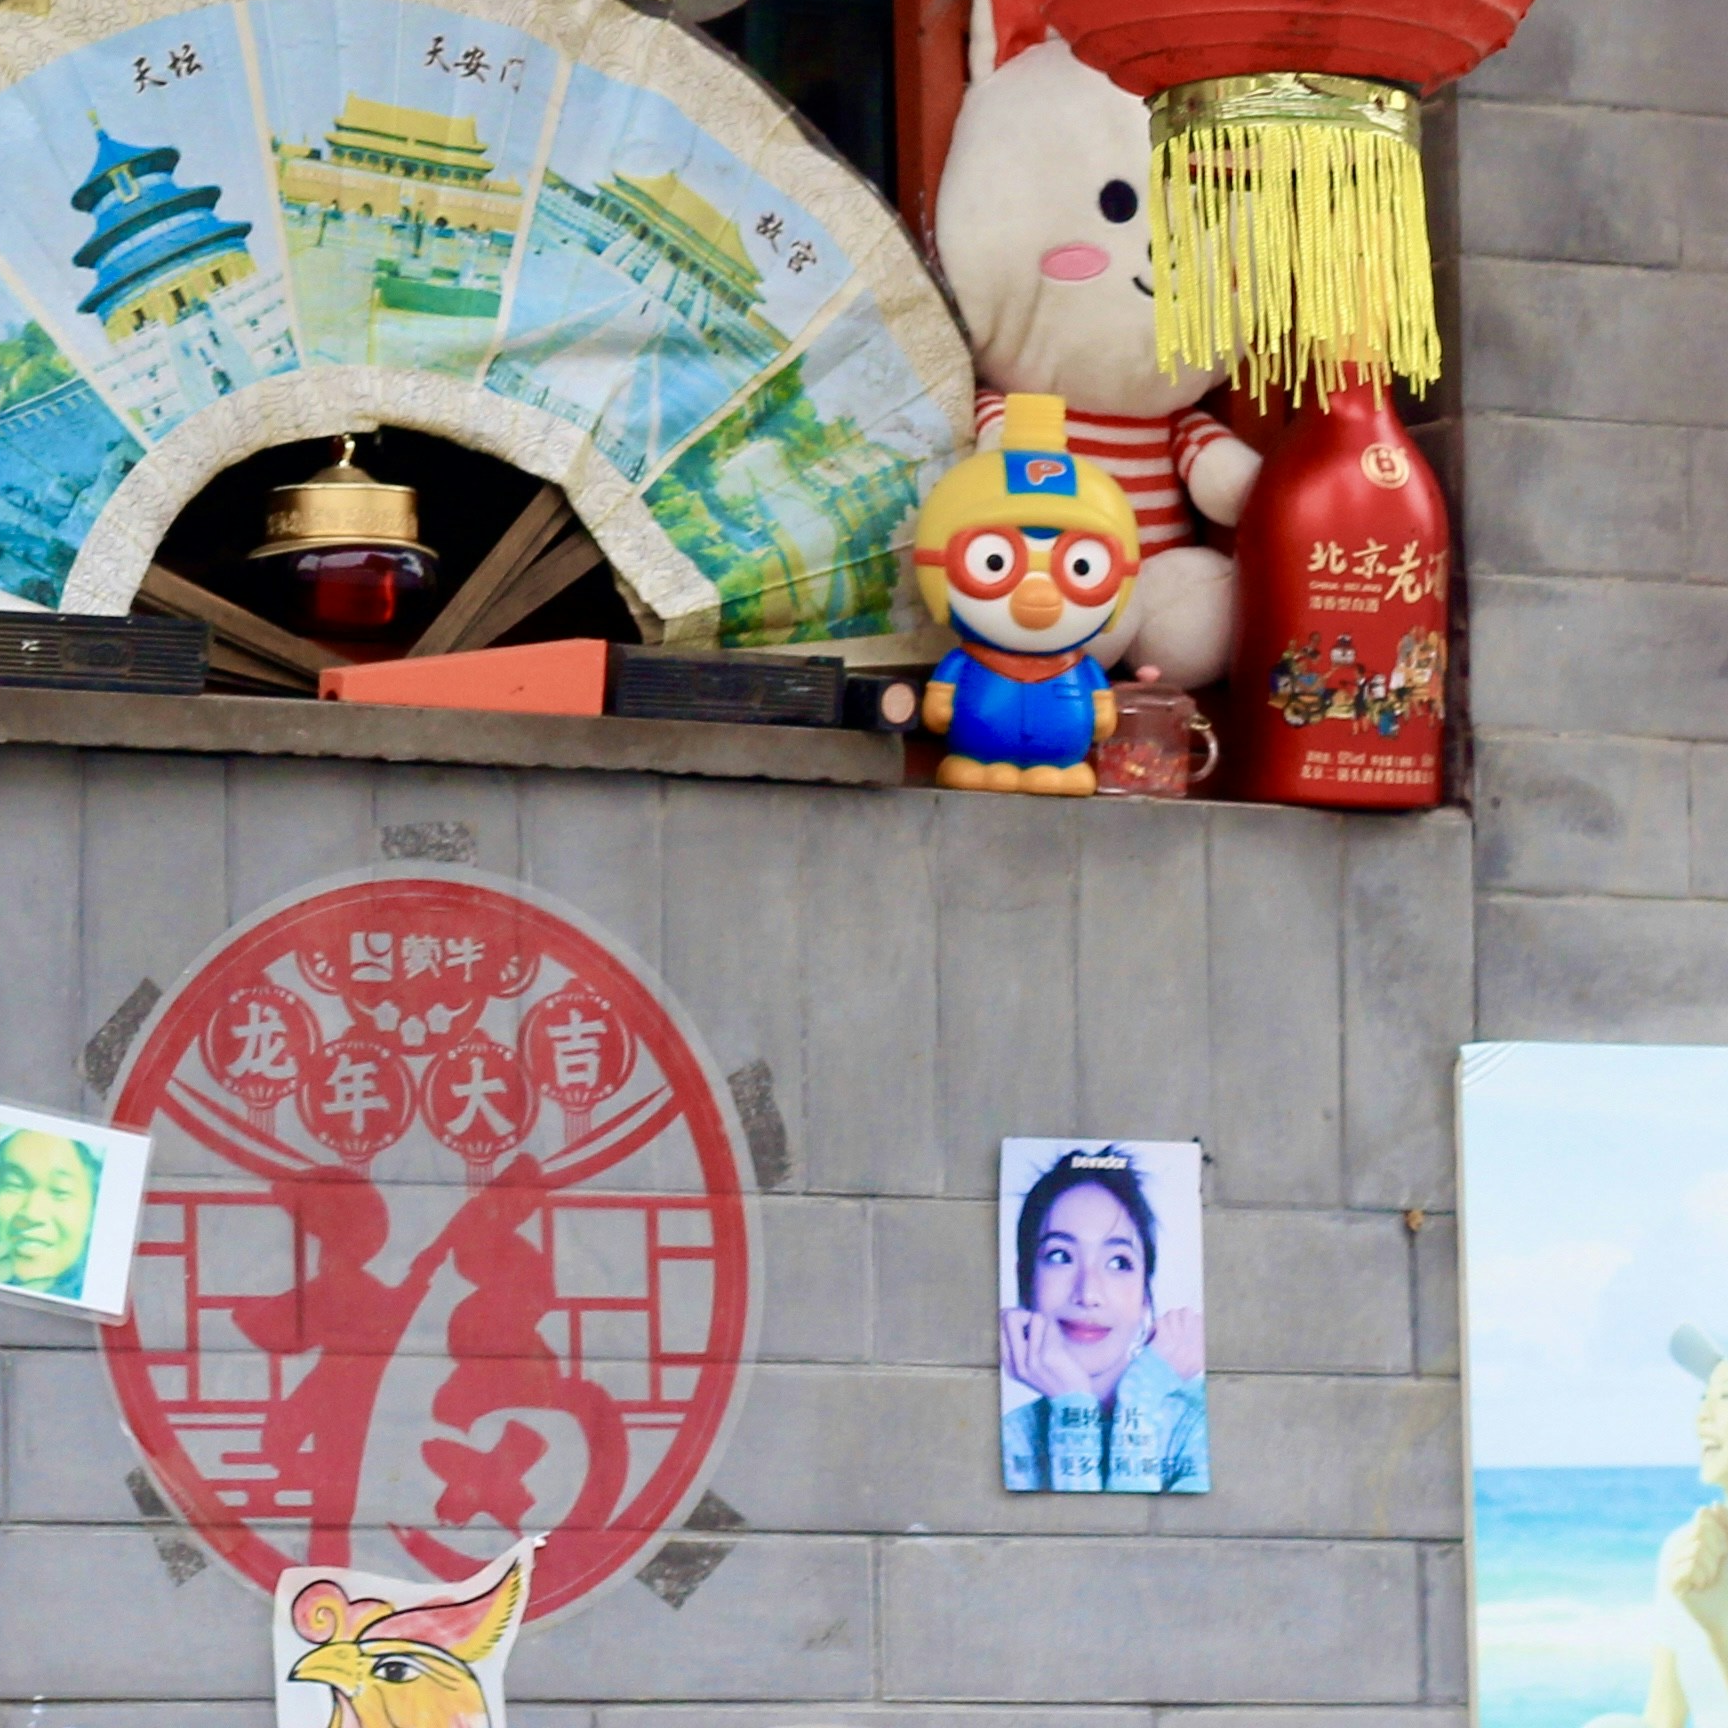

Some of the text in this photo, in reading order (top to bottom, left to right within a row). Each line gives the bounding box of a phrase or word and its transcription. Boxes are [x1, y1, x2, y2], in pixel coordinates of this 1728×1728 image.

[131, 43, 204, 93] 天坛
[421, 34, 526, 94] 天安门
[754, 212, 818, 276] 故宫
[400, 933, 486, 983] 蒙牛
[226, 1000, 612, 1140] 龙年大吉
